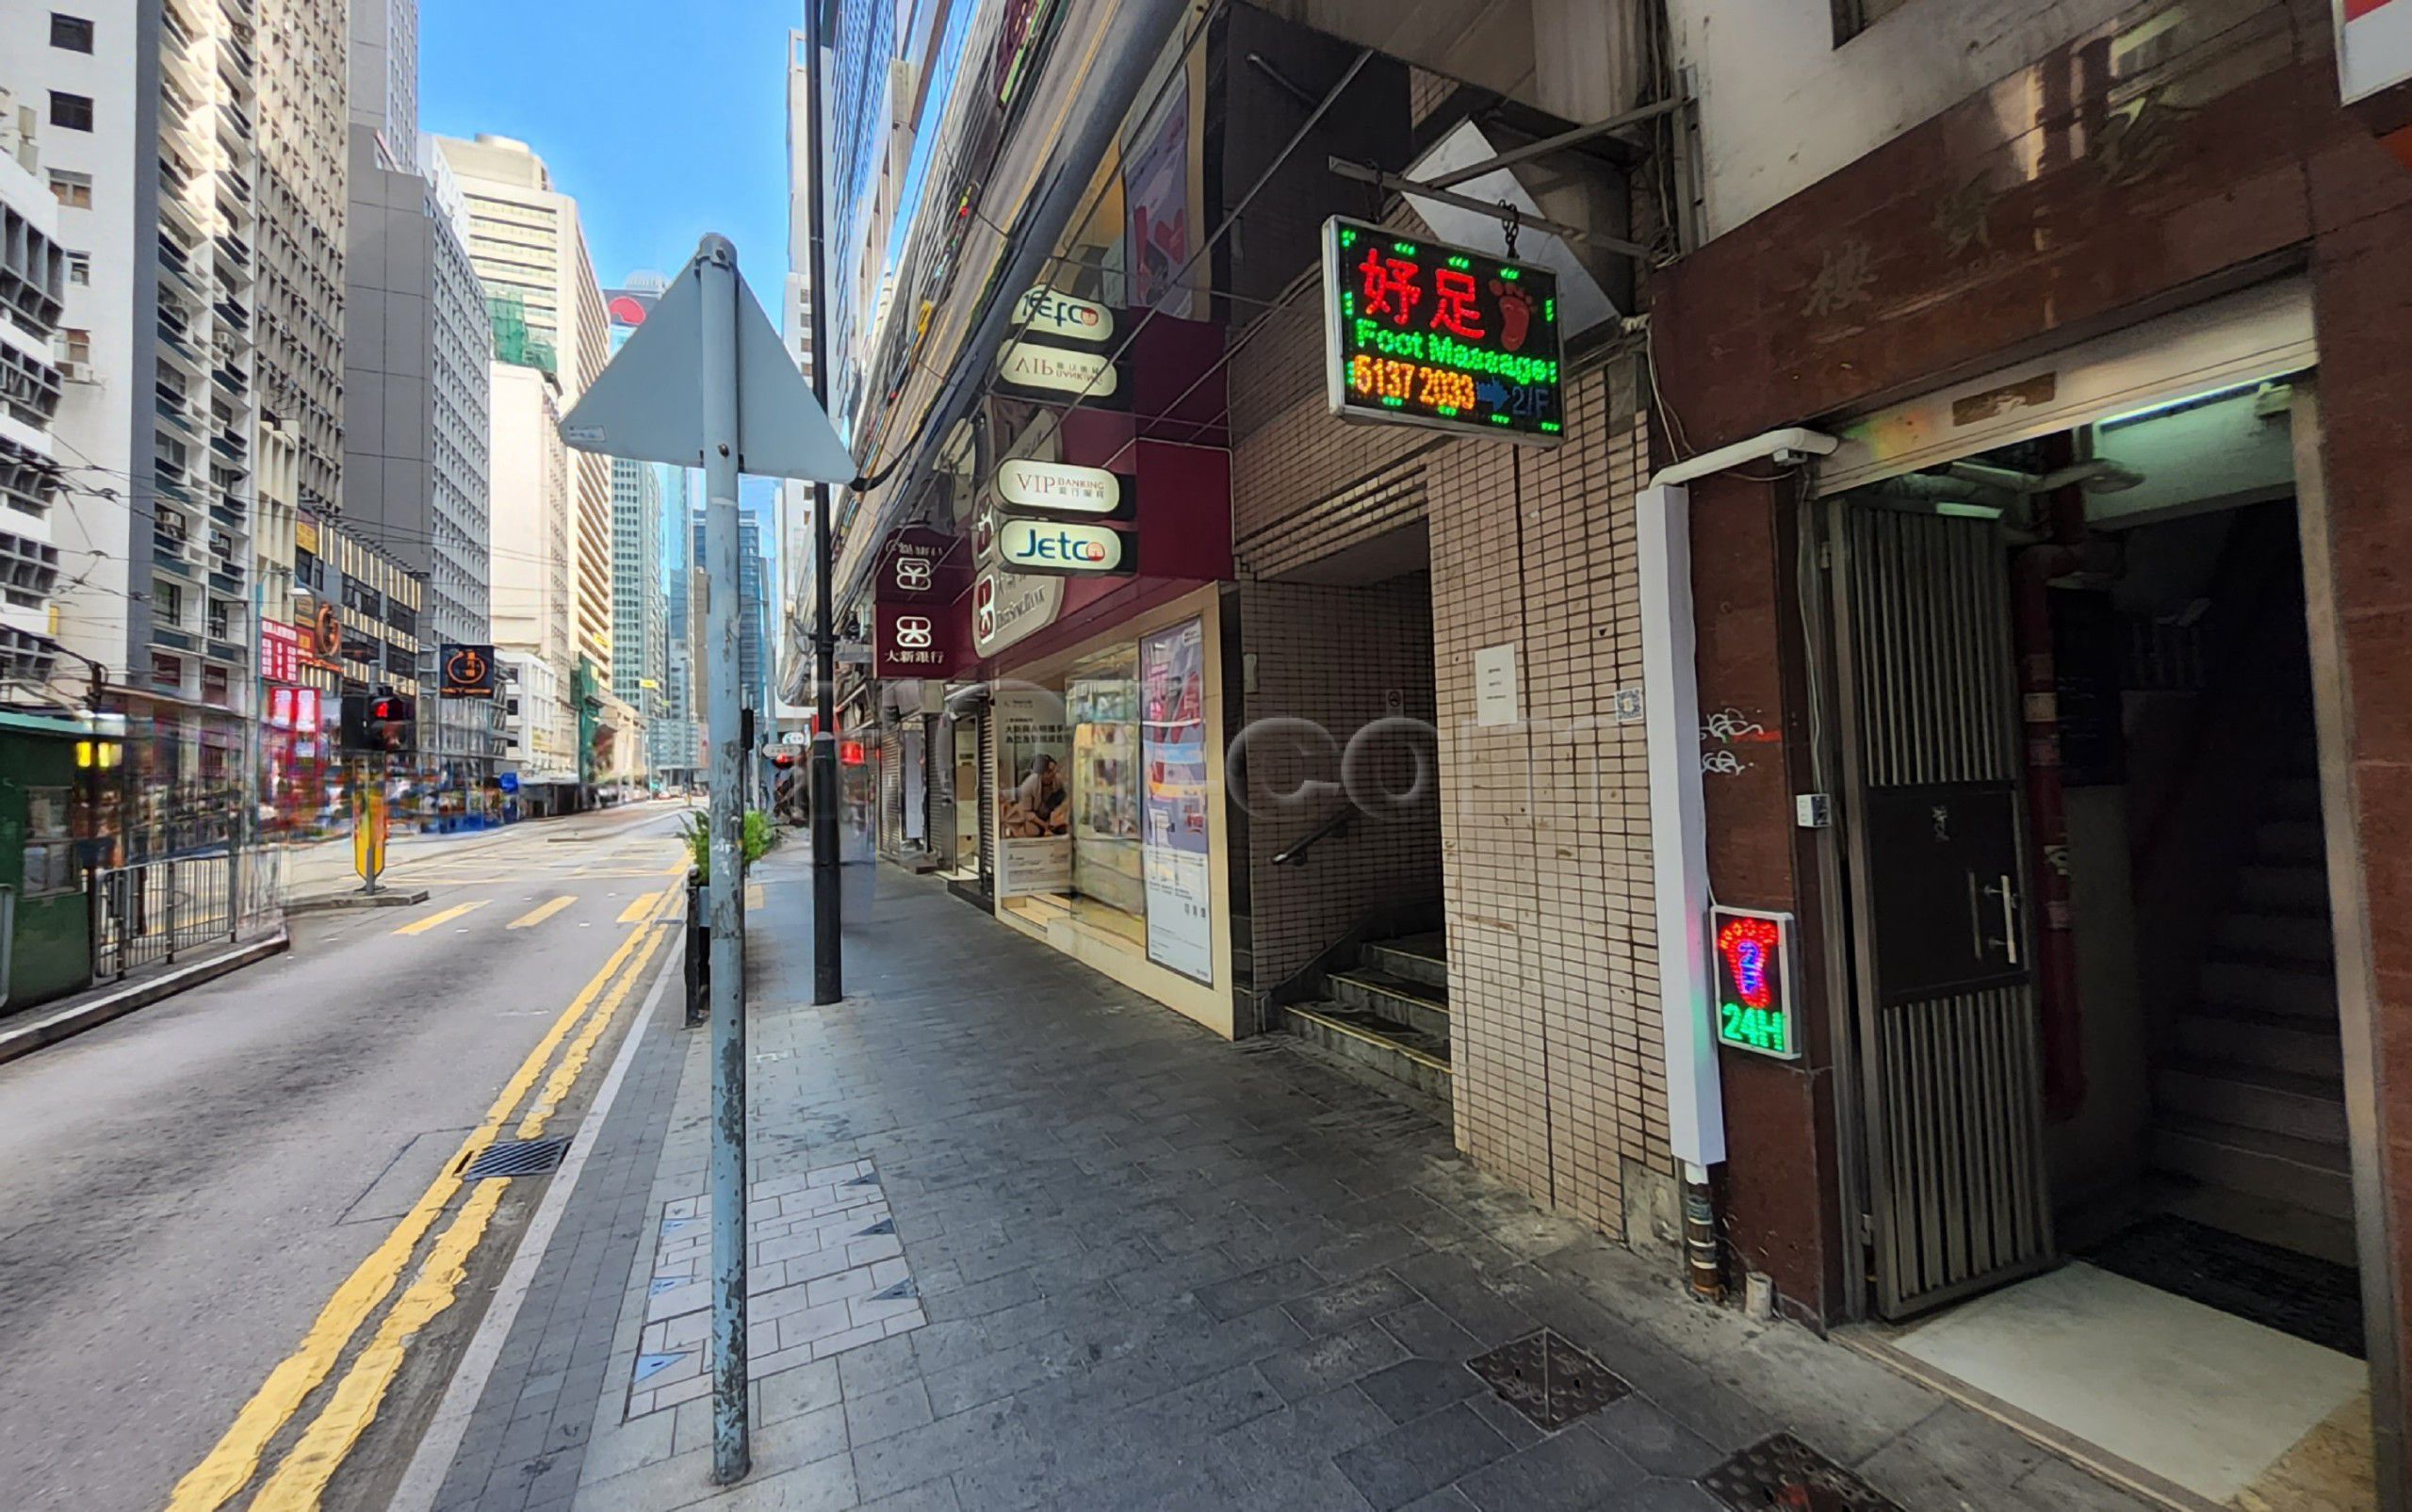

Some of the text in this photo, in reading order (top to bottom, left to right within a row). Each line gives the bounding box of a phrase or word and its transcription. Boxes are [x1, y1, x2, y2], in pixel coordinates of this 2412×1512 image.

[1356, 318, 1424, 359] Foot
[1511, 385, 1550, 417] 2/F
[1017, 473, 1056, 495] VIP
[1058, 478, 1105, 490] BANKING
[1017, 528, 1106, 562] Jetco
[885, 650, 945, 665] 大新銀行
[1722, 1002, 1785, 1051] 24H
